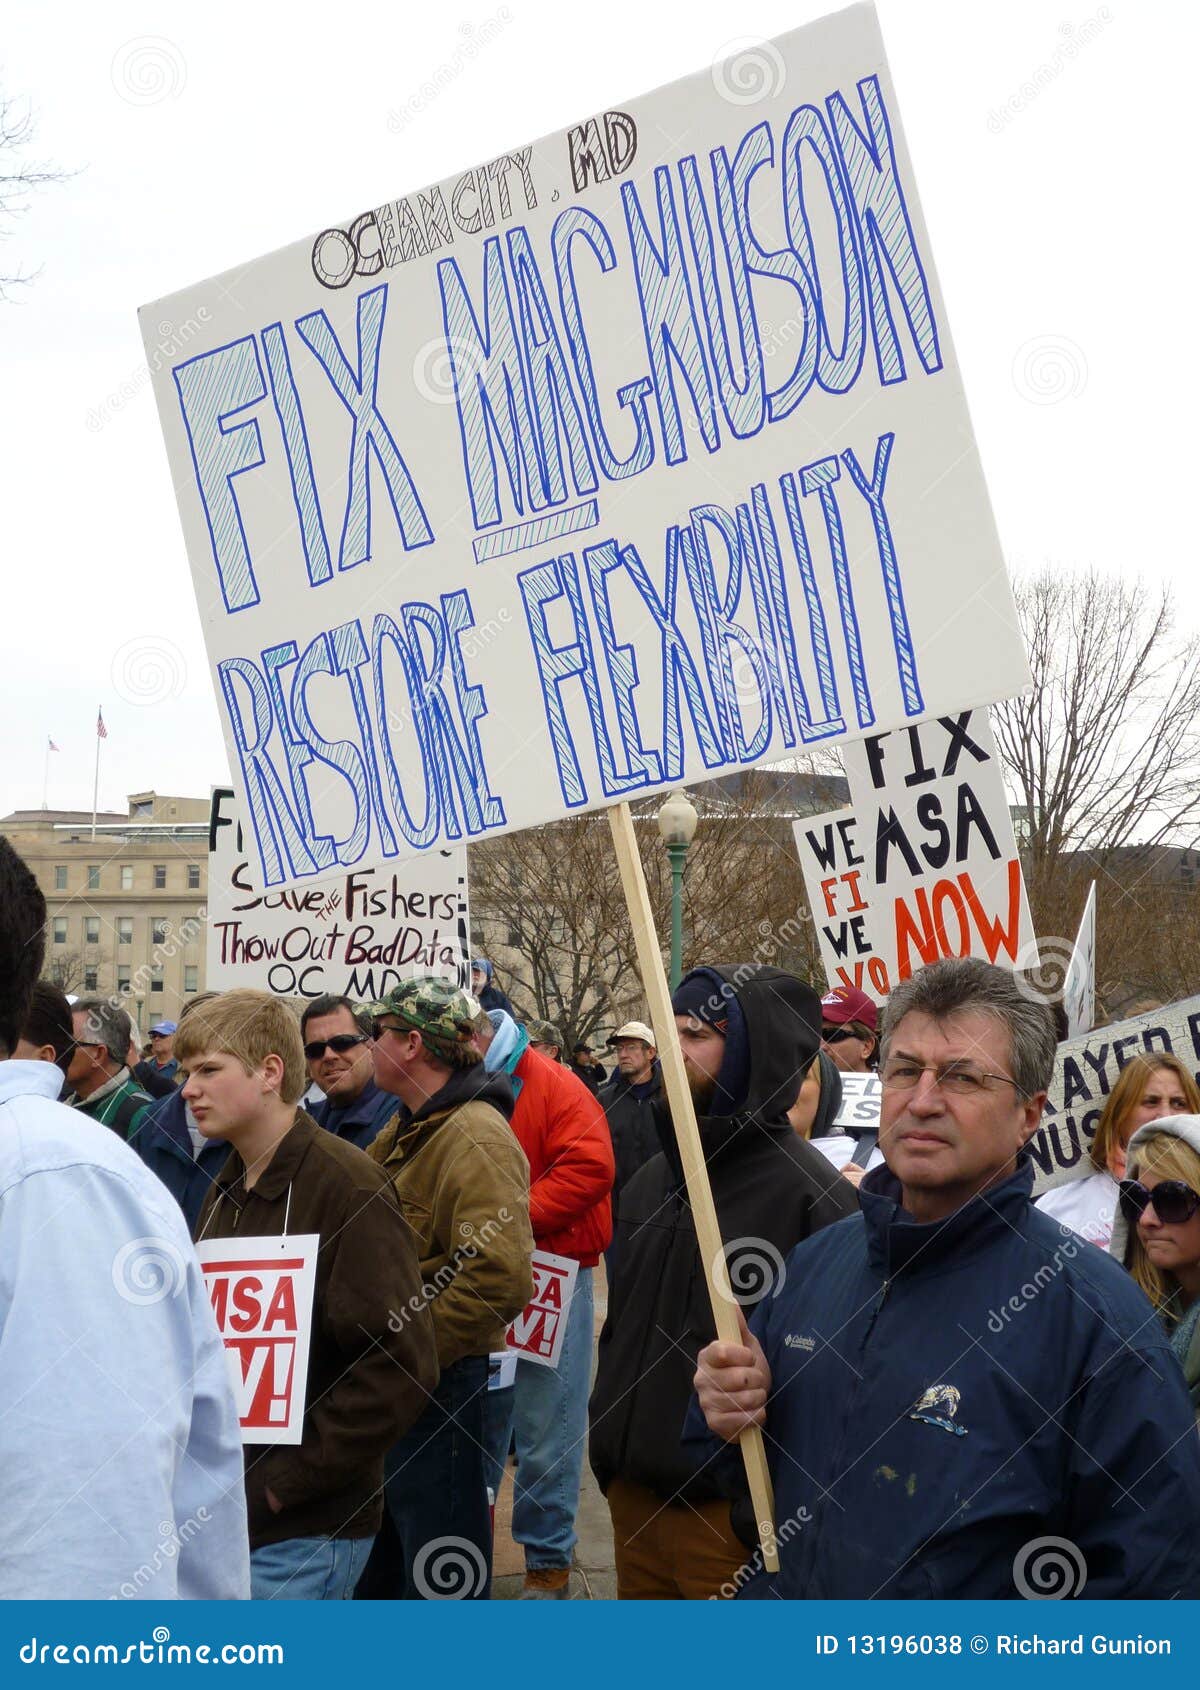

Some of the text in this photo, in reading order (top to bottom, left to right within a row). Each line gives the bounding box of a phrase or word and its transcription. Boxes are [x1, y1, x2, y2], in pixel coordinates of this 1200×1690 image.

[312, 186, 454, 289] OCEAN
[568, 111, 637, 193] MD
[172, 75, 942, 613] FIX MAGNUSON
[218, 433, 924, 887] RESTORE FLEXIBILITY
[863, 710, 991, 789] FIX
[805, 817, 864, 872] WE
[875, 782, 1002, 884] MSA
[315, 888, 342, 921] THE
[345, 868, 458, 922] Fishers
[822, 915, 873, 959] WE
[894, 859, 1021, 981] NOW
